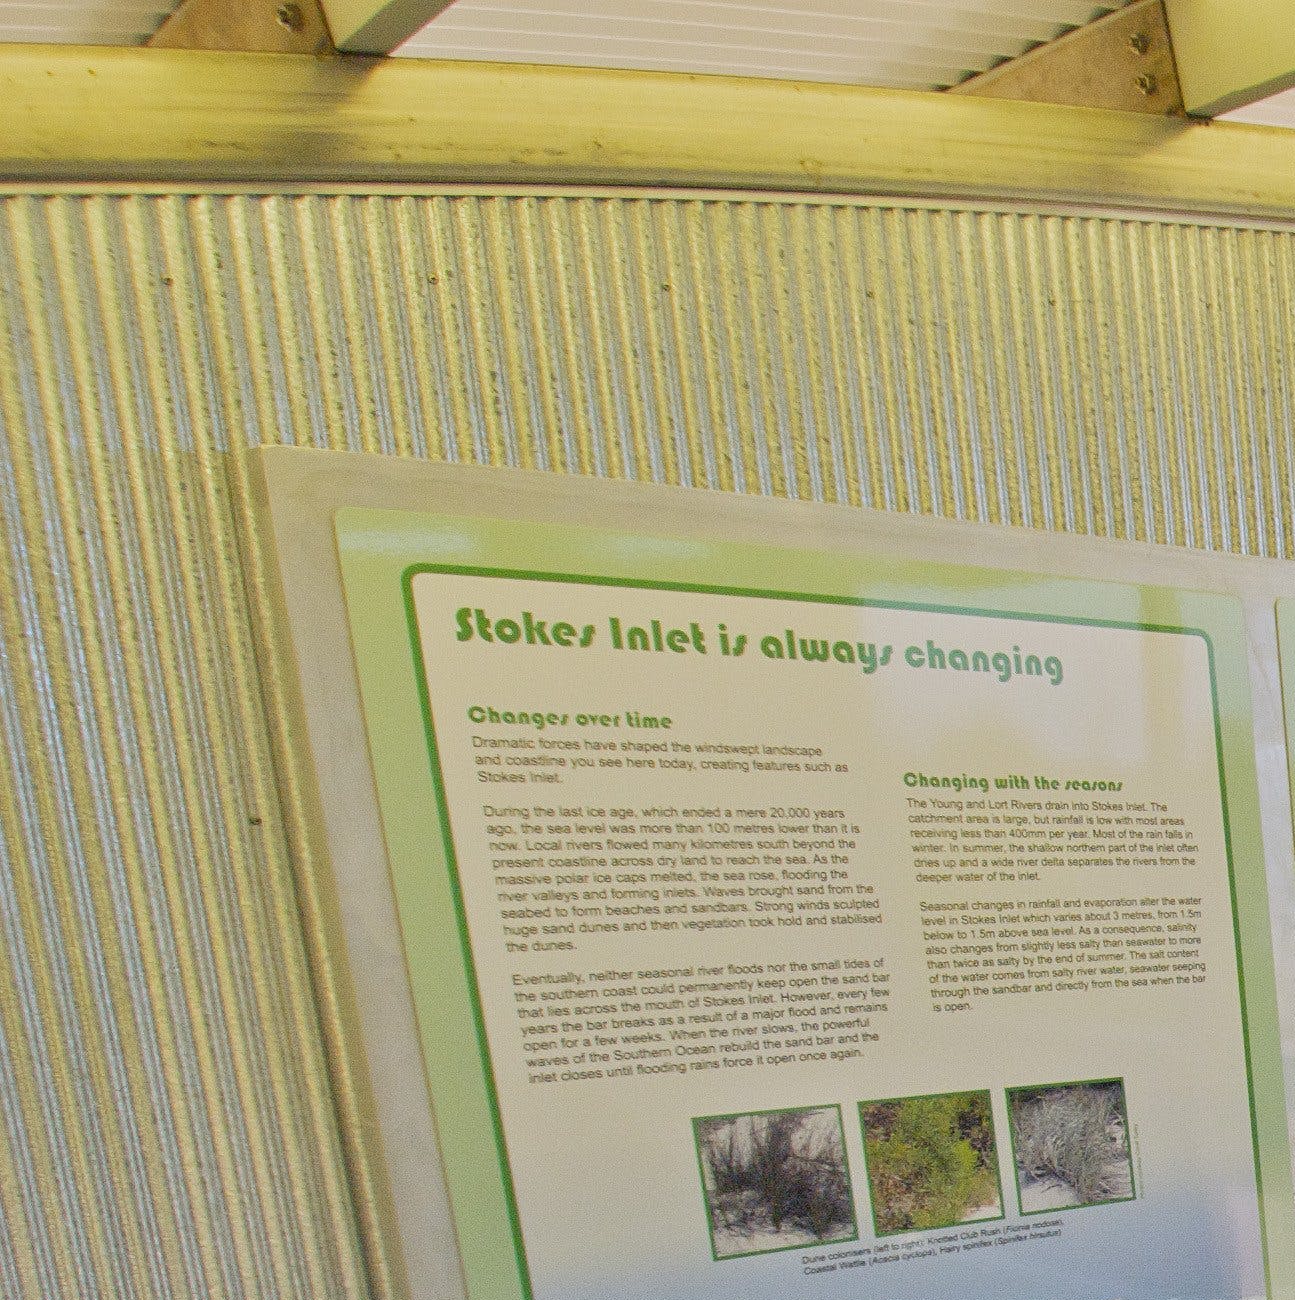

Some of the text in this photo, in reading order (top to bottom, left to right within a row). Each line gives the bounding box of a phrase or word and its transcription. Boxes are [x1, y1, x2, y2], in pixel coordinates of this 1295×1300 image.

[456, 607, 1064, 685] Stokes Inlet is always changing
[466, 705, 674, 729] Changes over time
[472, 736, 824, 759] Dramatic forces have shaped the windswept landscape
[474, 753, 502, 766] and
[504, 754, 567, 767] coastline
[570, 758, 595, 770] you
[598, 758, 623, 768] see
[625, 755, 655, 768] here
[699, 757, 749, 773] creating
[752, 757, 801, 770] features
[804, 759, 831, 771] such
[834, 762, 850, 771] as
[902, 771, 1124, 792] Changing with the seasons
[484, 804, 530, 819] During
[533, 804, 555, 817] the
[558, 804, 583, 817] last
[586, 805, 606, 817] ice
[641, 805, 679, 817] which
[681, 805, 721, 818] ended
[724, 809, 732, 818] a
[735, 809, 767, 818] mere
[813, 809, 846, 821] years
[492, 854, 544, 869] present
[547, 853, 607, 866] coastline
[610, 856, 654, 865] across
[656, 853, 677, 868] dry
[679, 852, 707, 865] land
[710, 852, 723, 864] to
[725, 852, 760, 864] reach
[763, 852, 782, 864] the
[812, 851, 828, 864] As
[830, 851, 850, 863] the
